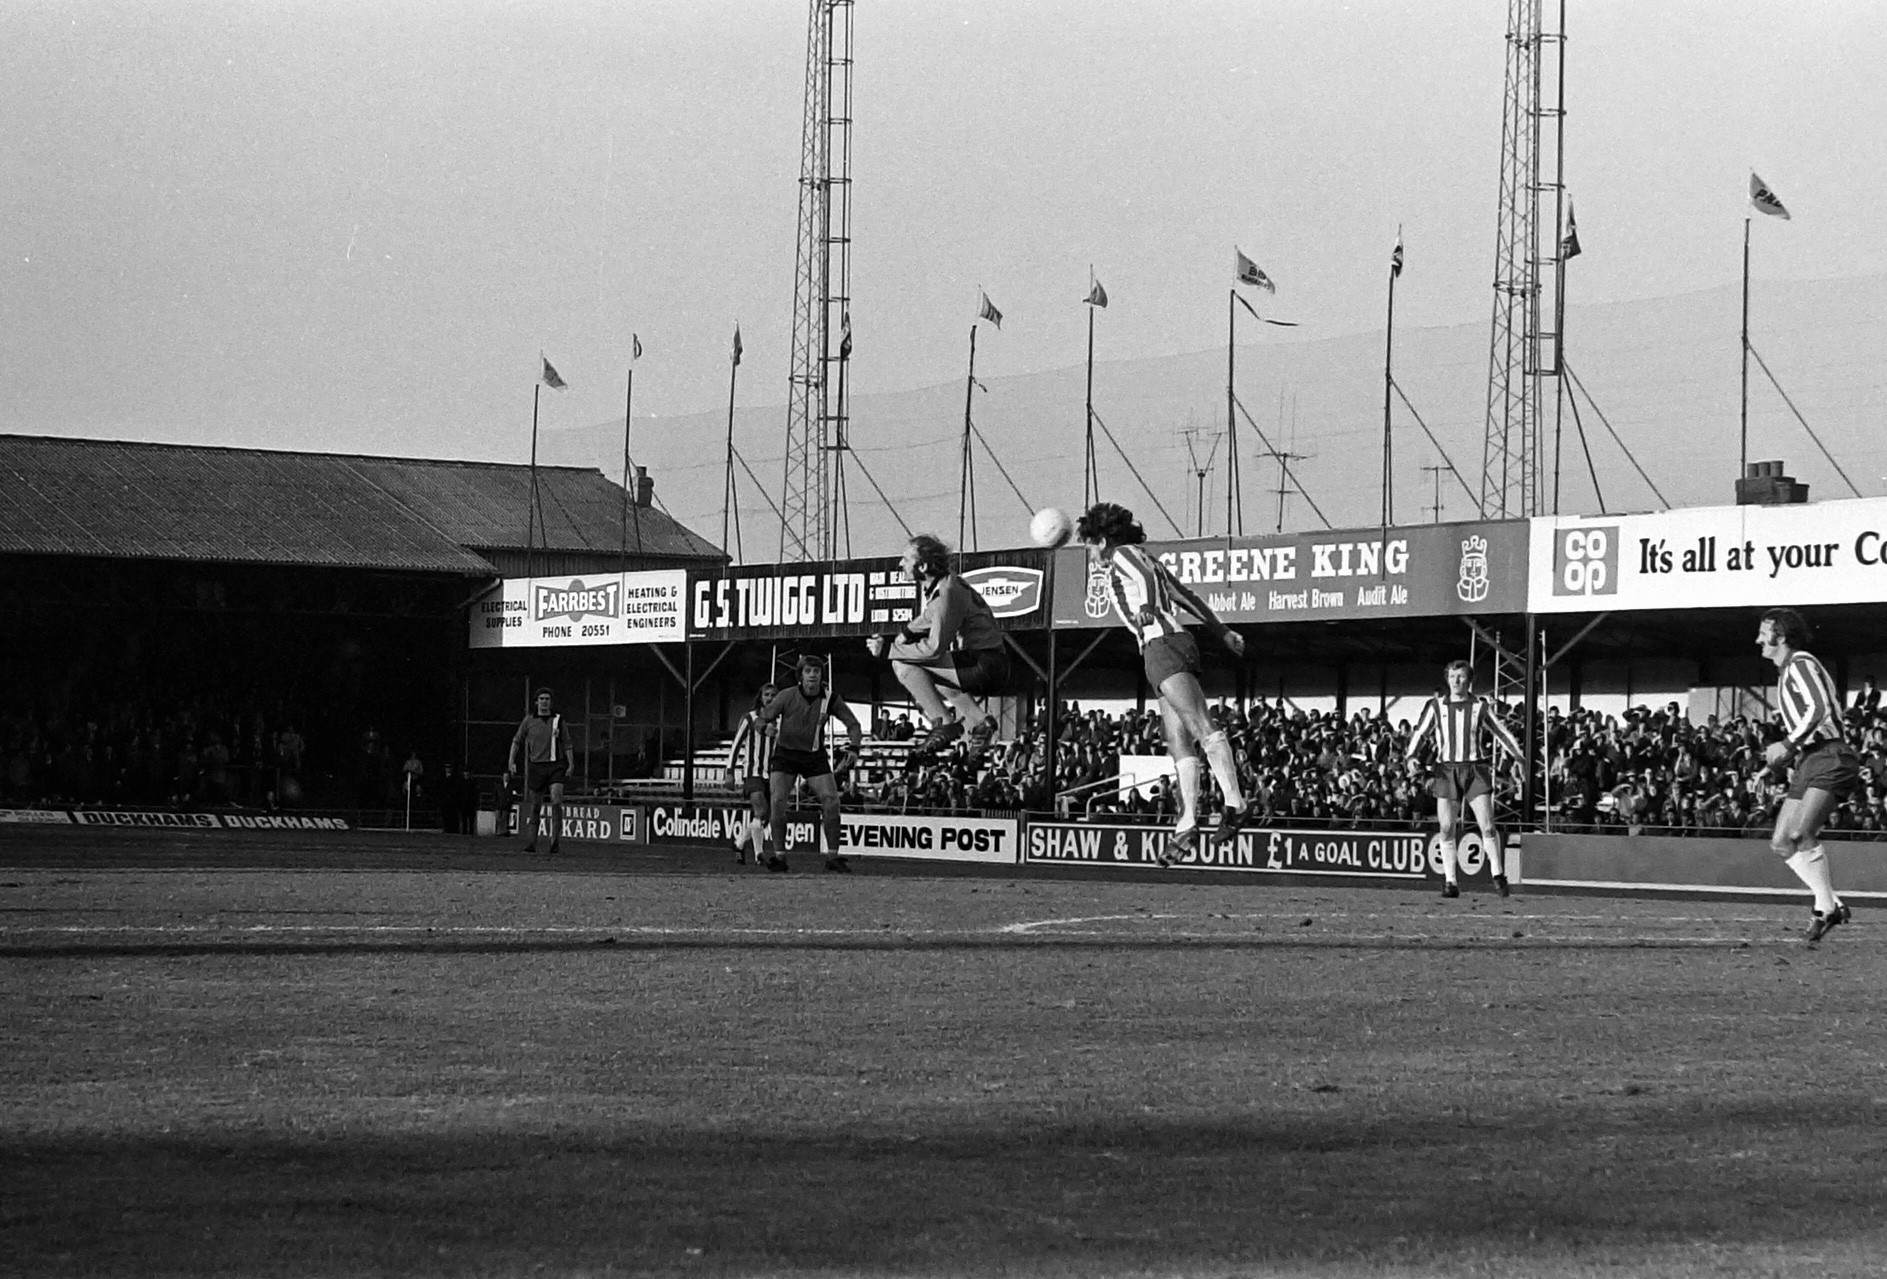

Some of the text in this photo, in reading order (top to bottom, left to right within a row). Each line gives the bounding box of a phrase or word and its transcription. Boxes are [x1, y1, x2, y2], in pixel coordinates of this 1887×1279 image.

[1158, 539, 1410, 584] GREENE KING
[1639, 537, 1673, 574] It's
[1682, 536, 1716, 572] all
[1726, 540, 1755, 571] at
[1766, 543, 1840, 578] your
[538, 584, 618, 618] FARRBEST
[628, 585, 678, 599] HEATING &
[822, 573, 865, 624] LTD
[981, 585, 1019, 596] JENSEN
[1207, 591, 1237, 612] Abbot
[1240, 590, 1256, 611] Ale
[1268, 589, 1308, 610] Harvest
[1312, 588, 1344, 608] Brown
[1357, 585, 1387, 606] Audit
[1390, 584, 1408, 605] Ale
[481, 600, 527, 613] ELECTRICAL
[627, 601, 677, 614] ELECTRICAL
[486, 617, 522, 628] SUPPLIES
[543, 625, 610, 638] PHONE 20551
[627, 616, 676, 629] ENGINEERS
[84, 812, 216, 827] DUCKHAMS
[224, 815, 350, 830] DUCKHAMS
[526, 817, 611, 839] AKARD
[653, 807, 721, 839] Colindale
[838, 824, 1006, 852] EVENING POST
[1031, 828, 1102, 859] SHAW
[1113, 830, 1129, 861] &
[1141, 831, 1253, 865] KIURN
[1298, 840, 1310, 861] A
[1314, 841, 1362, 867] GOAL
[1367, 838, 1426, 873] CLUB
[1468, 843, 1480, 864] 2
